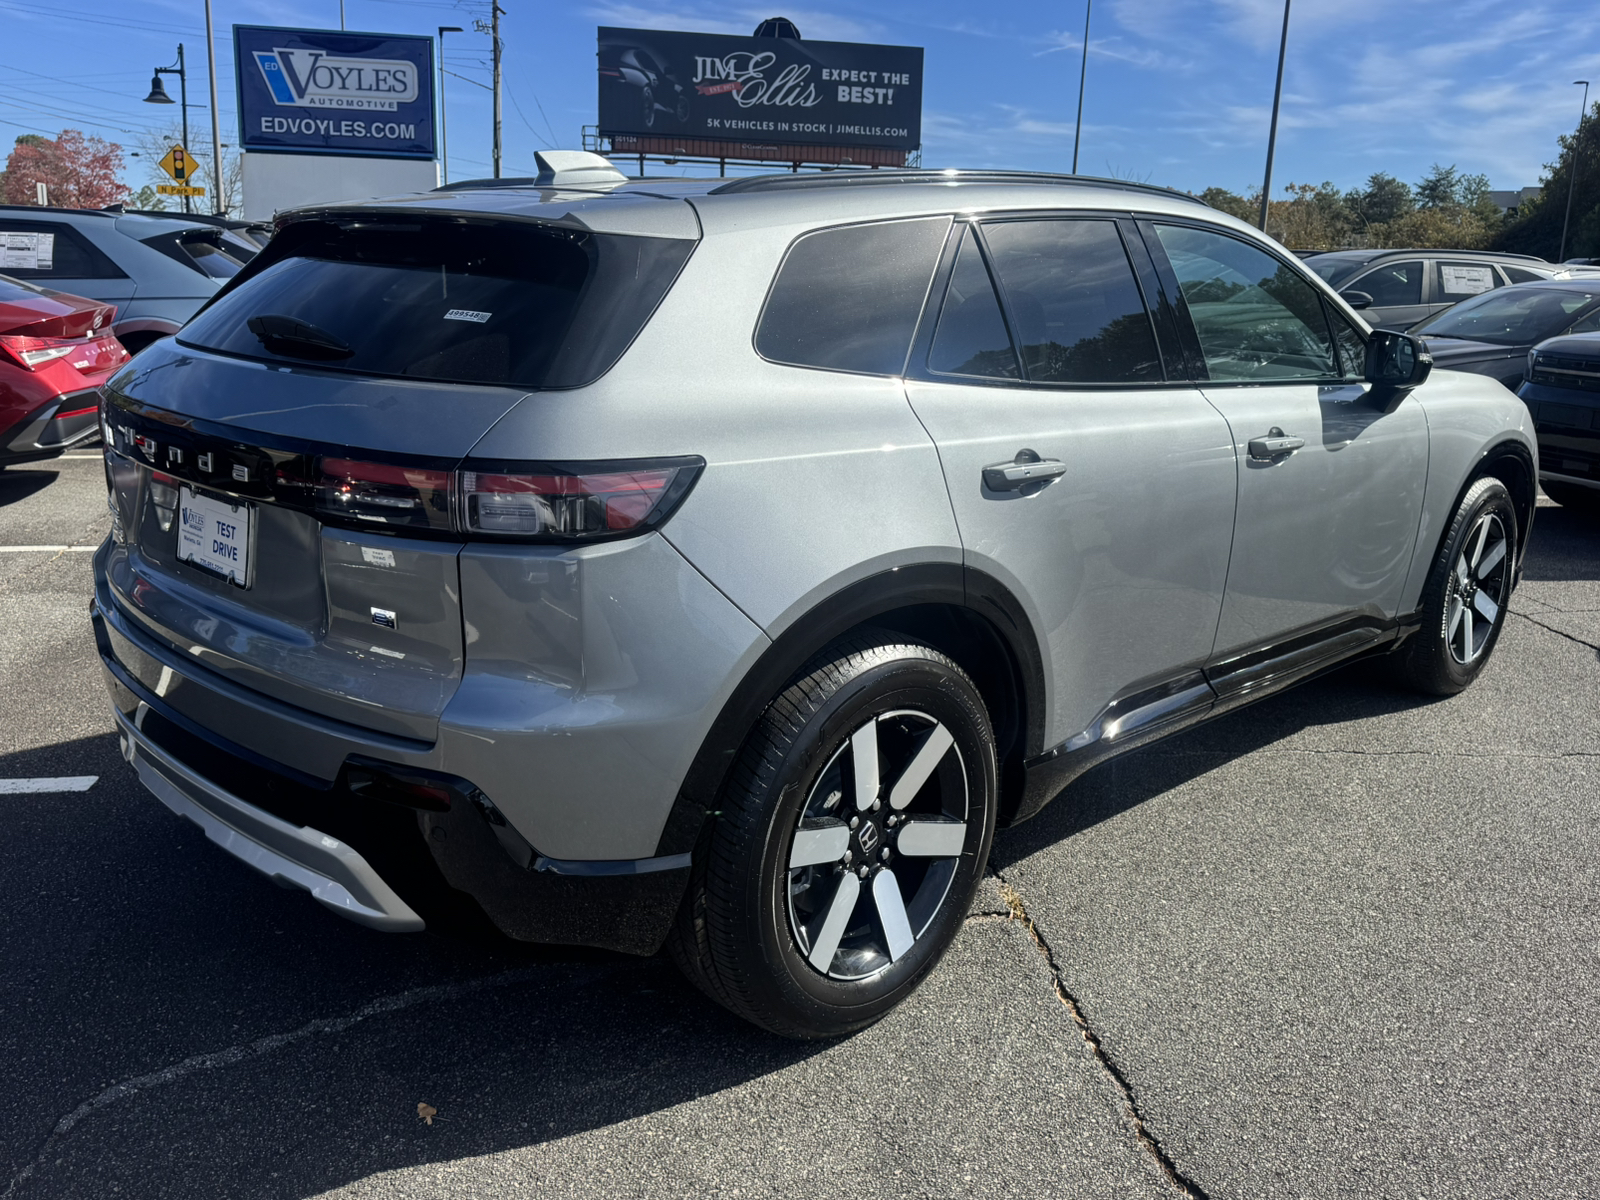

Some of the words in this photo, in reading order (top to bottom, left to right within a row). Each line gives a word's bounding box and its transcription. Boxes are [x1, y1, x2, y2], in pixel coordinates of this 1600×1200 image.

[264, 62, 279, 71] ED
[277, 51, 408, 99] VOYLES
[692, 56, 738, 82] JIM
[722, 51, 824, 108] Ellis
[821, 68, 878, 83] EXPECT
[882, 72, 910, 85] THE
[308, 97, 396, 109] AUTOMOTIVE
[837, 85, 894, 105] BEST!
[260, 116, 416, 140] EDVOYLES.COM
[707, 118, 721, 128] 5K
[724, 119, 775, 131] VEHICLES
[778, 122, 789, 131] IN
[792, 122, 827, 133] STOCK
[836, 124, 908, 137] JIMELLIS.COM
[171, 186, 188, 195] Park
[216, 520, 237, 540] TEST
[212, 539, 238, 562] DRIVE
